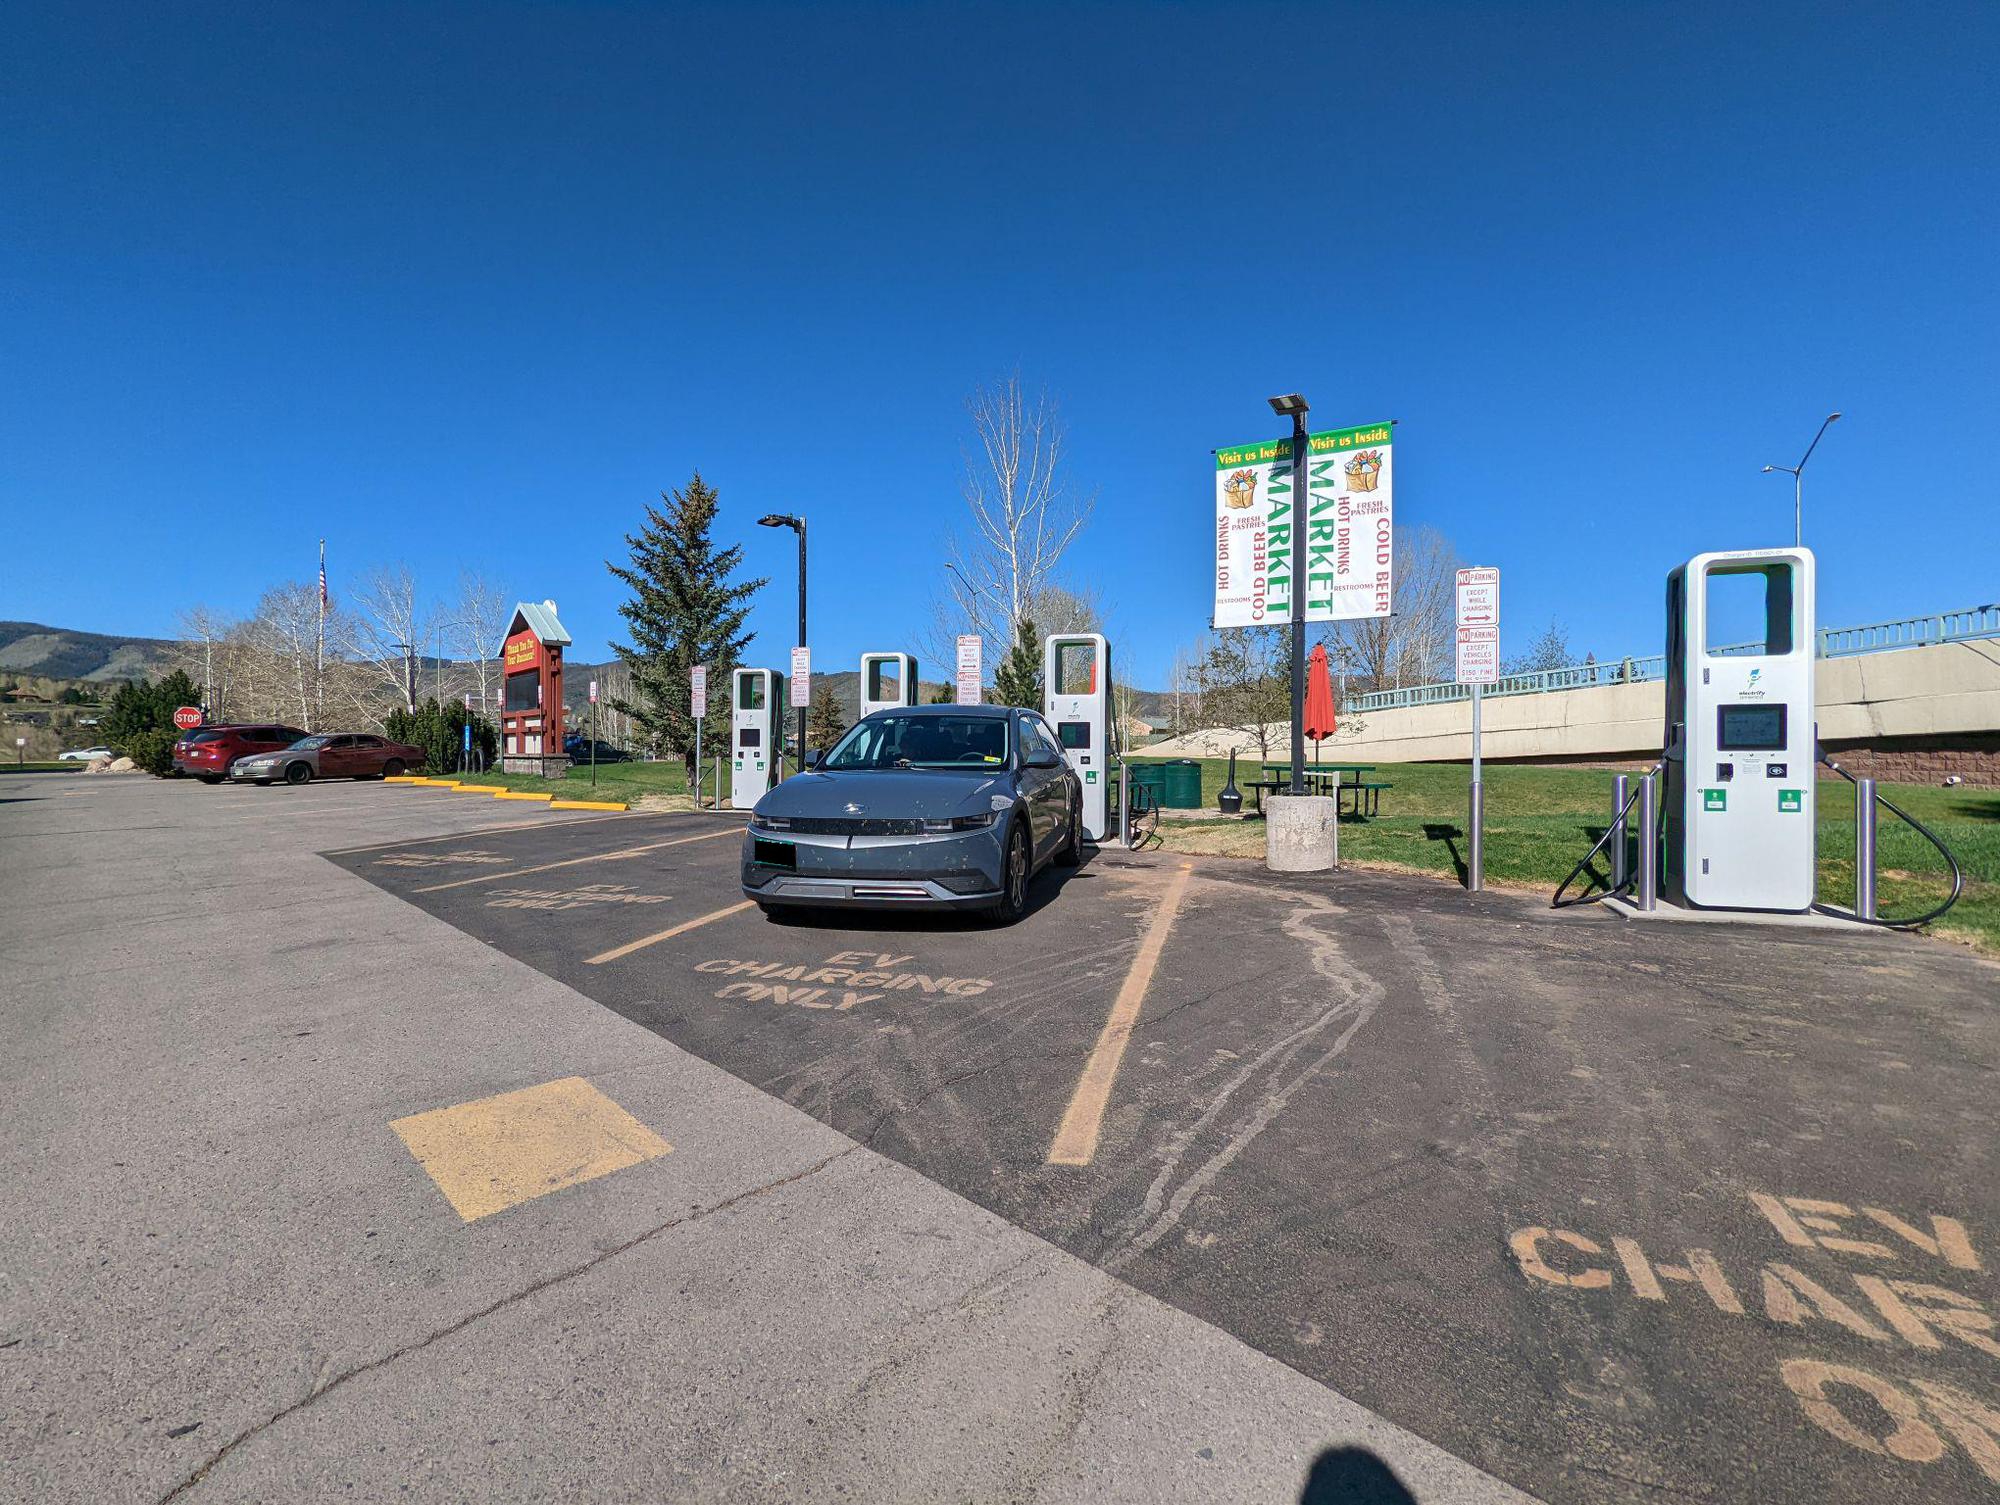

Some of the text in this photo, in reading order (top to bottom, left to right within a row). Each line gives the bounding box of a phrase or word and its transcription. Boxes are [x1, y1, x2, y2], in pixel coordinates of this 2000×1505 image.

[1310, 428, 1388, 451] Visit us Inside
[1219, 446, 1291, 465] Visit us Inside
[1351, 506, 1389, 516] PASTRIES
[1357, 500, 1383, 510] FRESH
[1232, 521, 1266, 531] PASTRIES
[1237, 516, 1261, 524] FRESH
[1267, 465, 1292, 617] MARKET
[1308, 459, 1335, 615] MARKET
[1337, 496, 1350, 575] HOT DRINKS
[1218, 515, 1230, 590] HOT DRINKS
[1375, 517, 1390, 612] COLD BEER
[1252, 531, 1266, 621] COLD BEER
[1459, 572, 1496, 584] NO PARKING
[1334, 583, 1374, 592] RESTROOMS
[1459, 629, 1496, 641] NO PARKING
[176, 714, 200, 723] STOP
[824, 950, 915, 968] EV
[693, 958, 994, 996] CHARGING
[714, 981, 886, 1011] ONLY
[1749, 1191, 1984, 1271] EV
